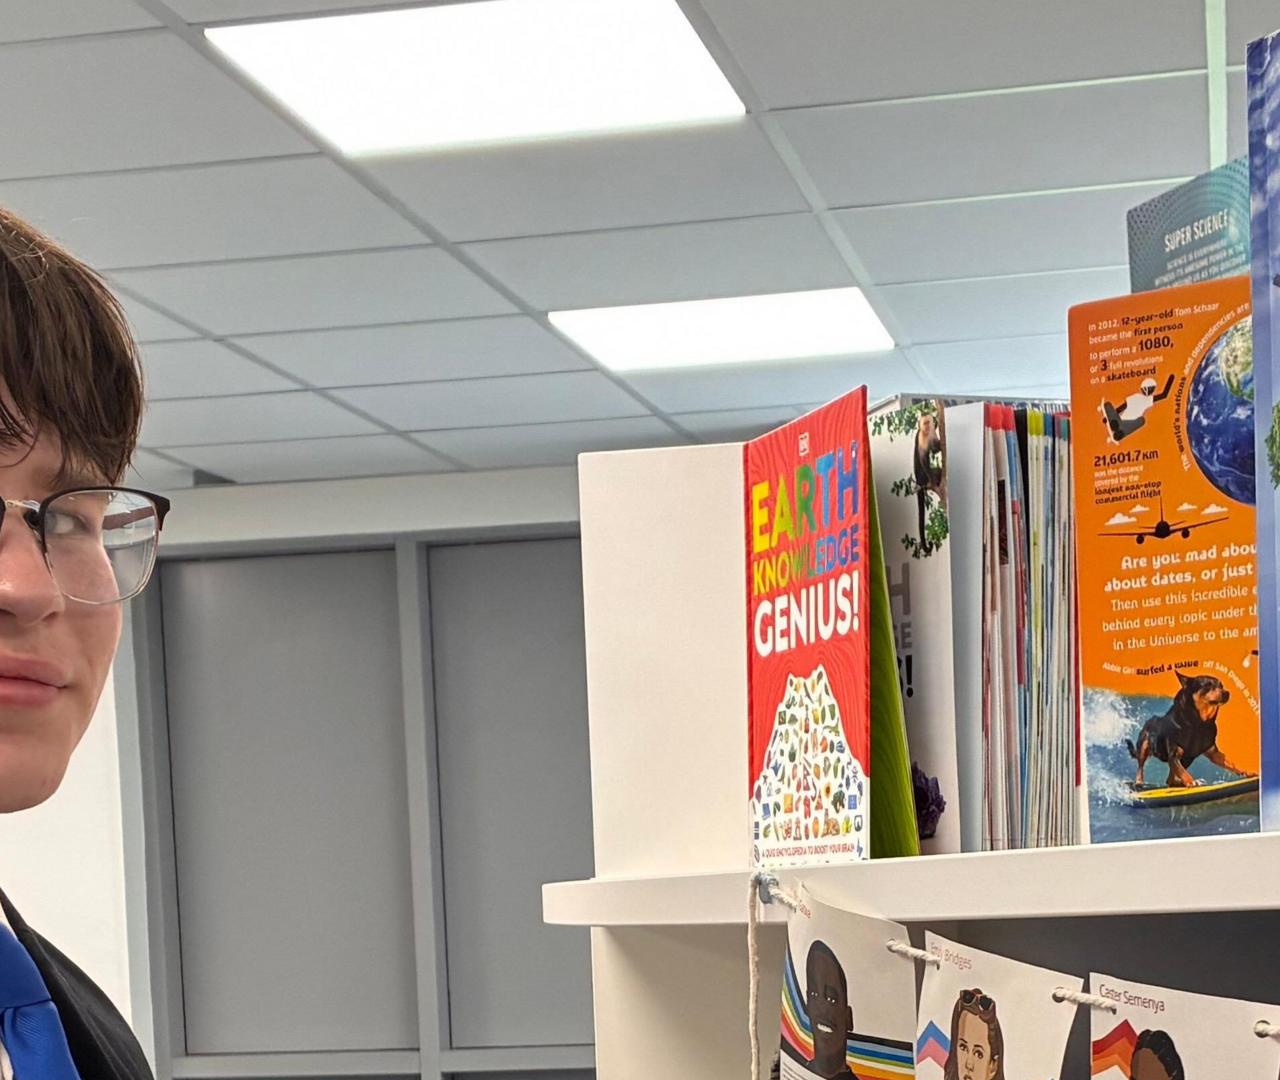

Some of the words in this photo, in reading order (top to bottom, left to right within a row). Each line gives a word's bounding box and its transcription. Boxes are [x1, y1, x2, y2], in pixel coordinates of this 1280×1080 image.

[1165, 225, 1192, 252] SUPER
[1193, 209, 1228, 240] SCIENCE
[1122, 309, 1174, 328] 12-year-old
[1174, 307, 1192, 317] Tom
[1090, 333, 1118, 345] became
[1120, 329, 1132, 339] the
[1134, 324, 1152, 337] first
[1153, 321, 1183, 335] person
[1191, 310, 1236, 360] dependencies
[1090, 351, 1098, 360] to
[1099, 345, 1131, 361] perform
[1132, 345, 1137, 354] a
[1138, 335, 1174, 352] 1080,
[1090, 366, 1099, 374] or
[1100, 359, 1107, 371] 3
[1109, 361, 1122, 371] full
[1124, 354, 1163, 368] revolutions
[1107, 365, 1156, 382] skateboard
[1094, 450, 1141, 467] 21,601.7
[752, 440, 859, 554] EARTH
[753, 524, 859, 596] KNOWLEDGE
[1121, 556, 1147, 570] Are
[1152, 553, 1180, 569] you
[1185, 544, 1217, 562] mad
[1104, 576, 1147, 593] about
[1151, 571, 1197, 586] dates,
[1201, 569, 1217, 580] or
[1221, 563, 1253, 582] just
[1111, 598, 1138, 611] Then
[1142, 597, 1161, 608] use
[1165, 590, 1187, 604] this
[1191, 584, 1248, 602] incredible
[754, 569, 859, 657] GENIUS!
[1102, 617, 1140, 632] behind
[1143, 615, 1175, 628] every
[1179, 609, 1208, 625] topic
[1211, 605, 1244, 619] under
[1113, 638, 1124, 650] in
[1127, 634, 1146, 649] the
[1149, 631, 1199, 646] Universe
[1203, 629, 1216, 641] to
[1219, 626, 1239, 640] the
[944, 948, 973, 970] Bridges
[1123, 990, 1166, 1013] Semenya
